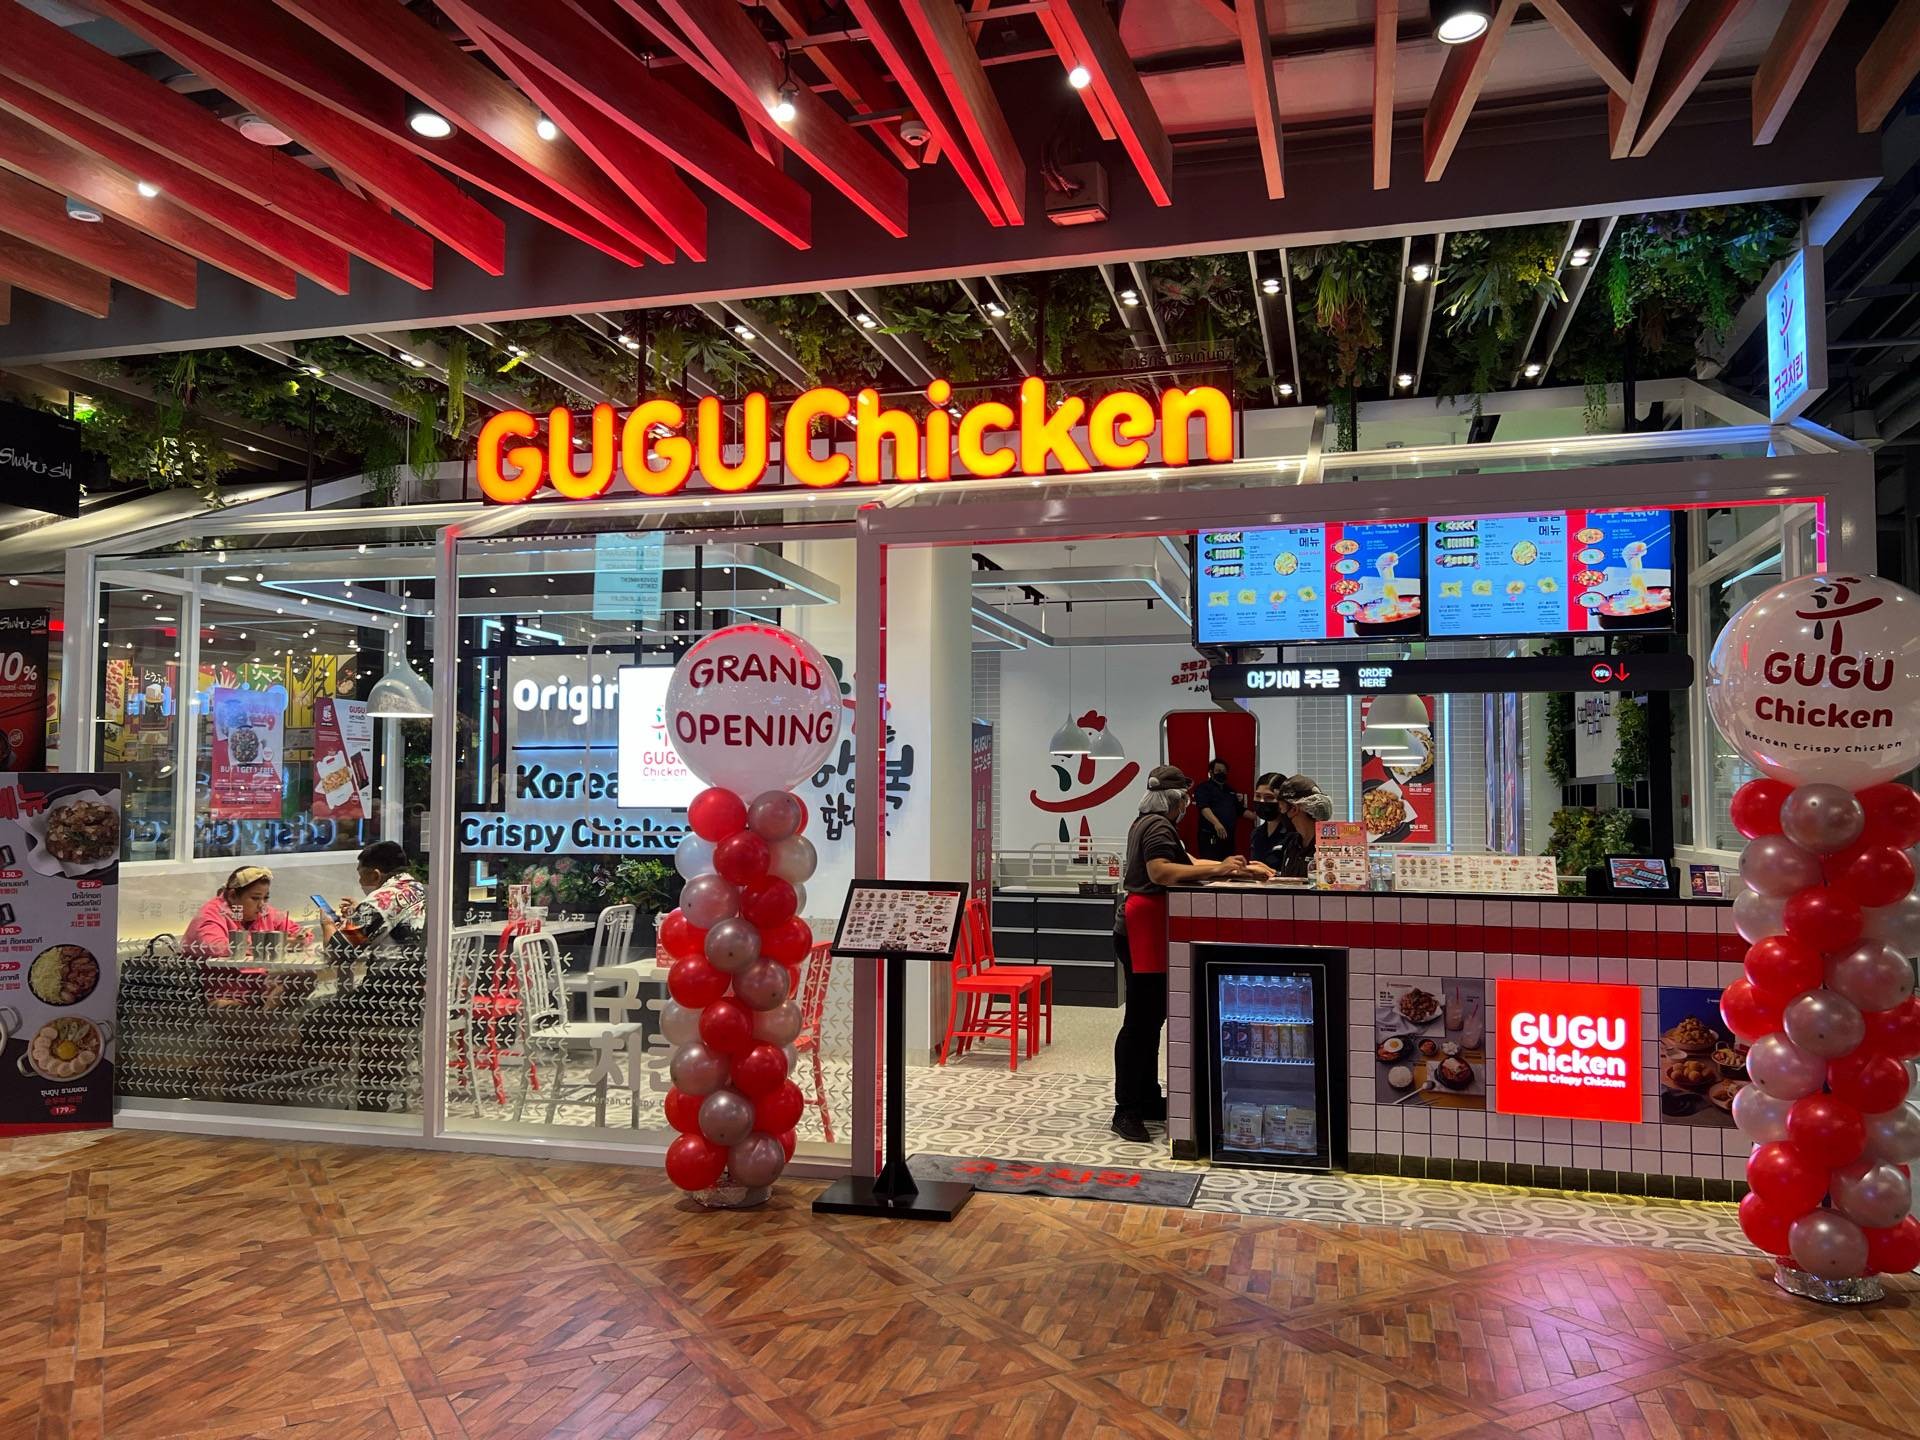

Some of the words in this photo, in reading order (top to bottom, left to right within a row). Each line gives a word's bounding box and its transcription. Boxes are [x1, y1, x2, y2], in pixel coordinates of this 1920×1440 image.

[1775, 351, 1804, 400] 구구치킨
[477, 391, 770, 503] GUGU
[784, 376, 1235, 487] Chicken
[690, 653, 823, 692] GRAND
[1247, 668, 1301, 690] 여기에
[1303, 668, 1340, 688] 주문
[1358, 667, 1392, 678] ORDER
[1359, 677, 1387, 688] HERE
[1764, 651, 1894, 692] GUGU
[675, 710, 833, 747] OPENING
[1755, 696, 1893, 729] Chicken
[1745, 729, 1788, 749] Korean
[1794, 743, 1840, 754] Crispy
[1845, 740, 1903, 753] Chicken
[643, 751, 682, 766] GUG
[460, 816, 565, 853] Crispy
[1510, 1012, 1626, 1051] GUGU
[1510, 1046, 1626, 1077] Chicken
[1510, 1071, 1548, 1083] Korean
[1549, 1074, 1582, 1087] Crispy
[1583, 1075, 1626, 1088] Chicken
